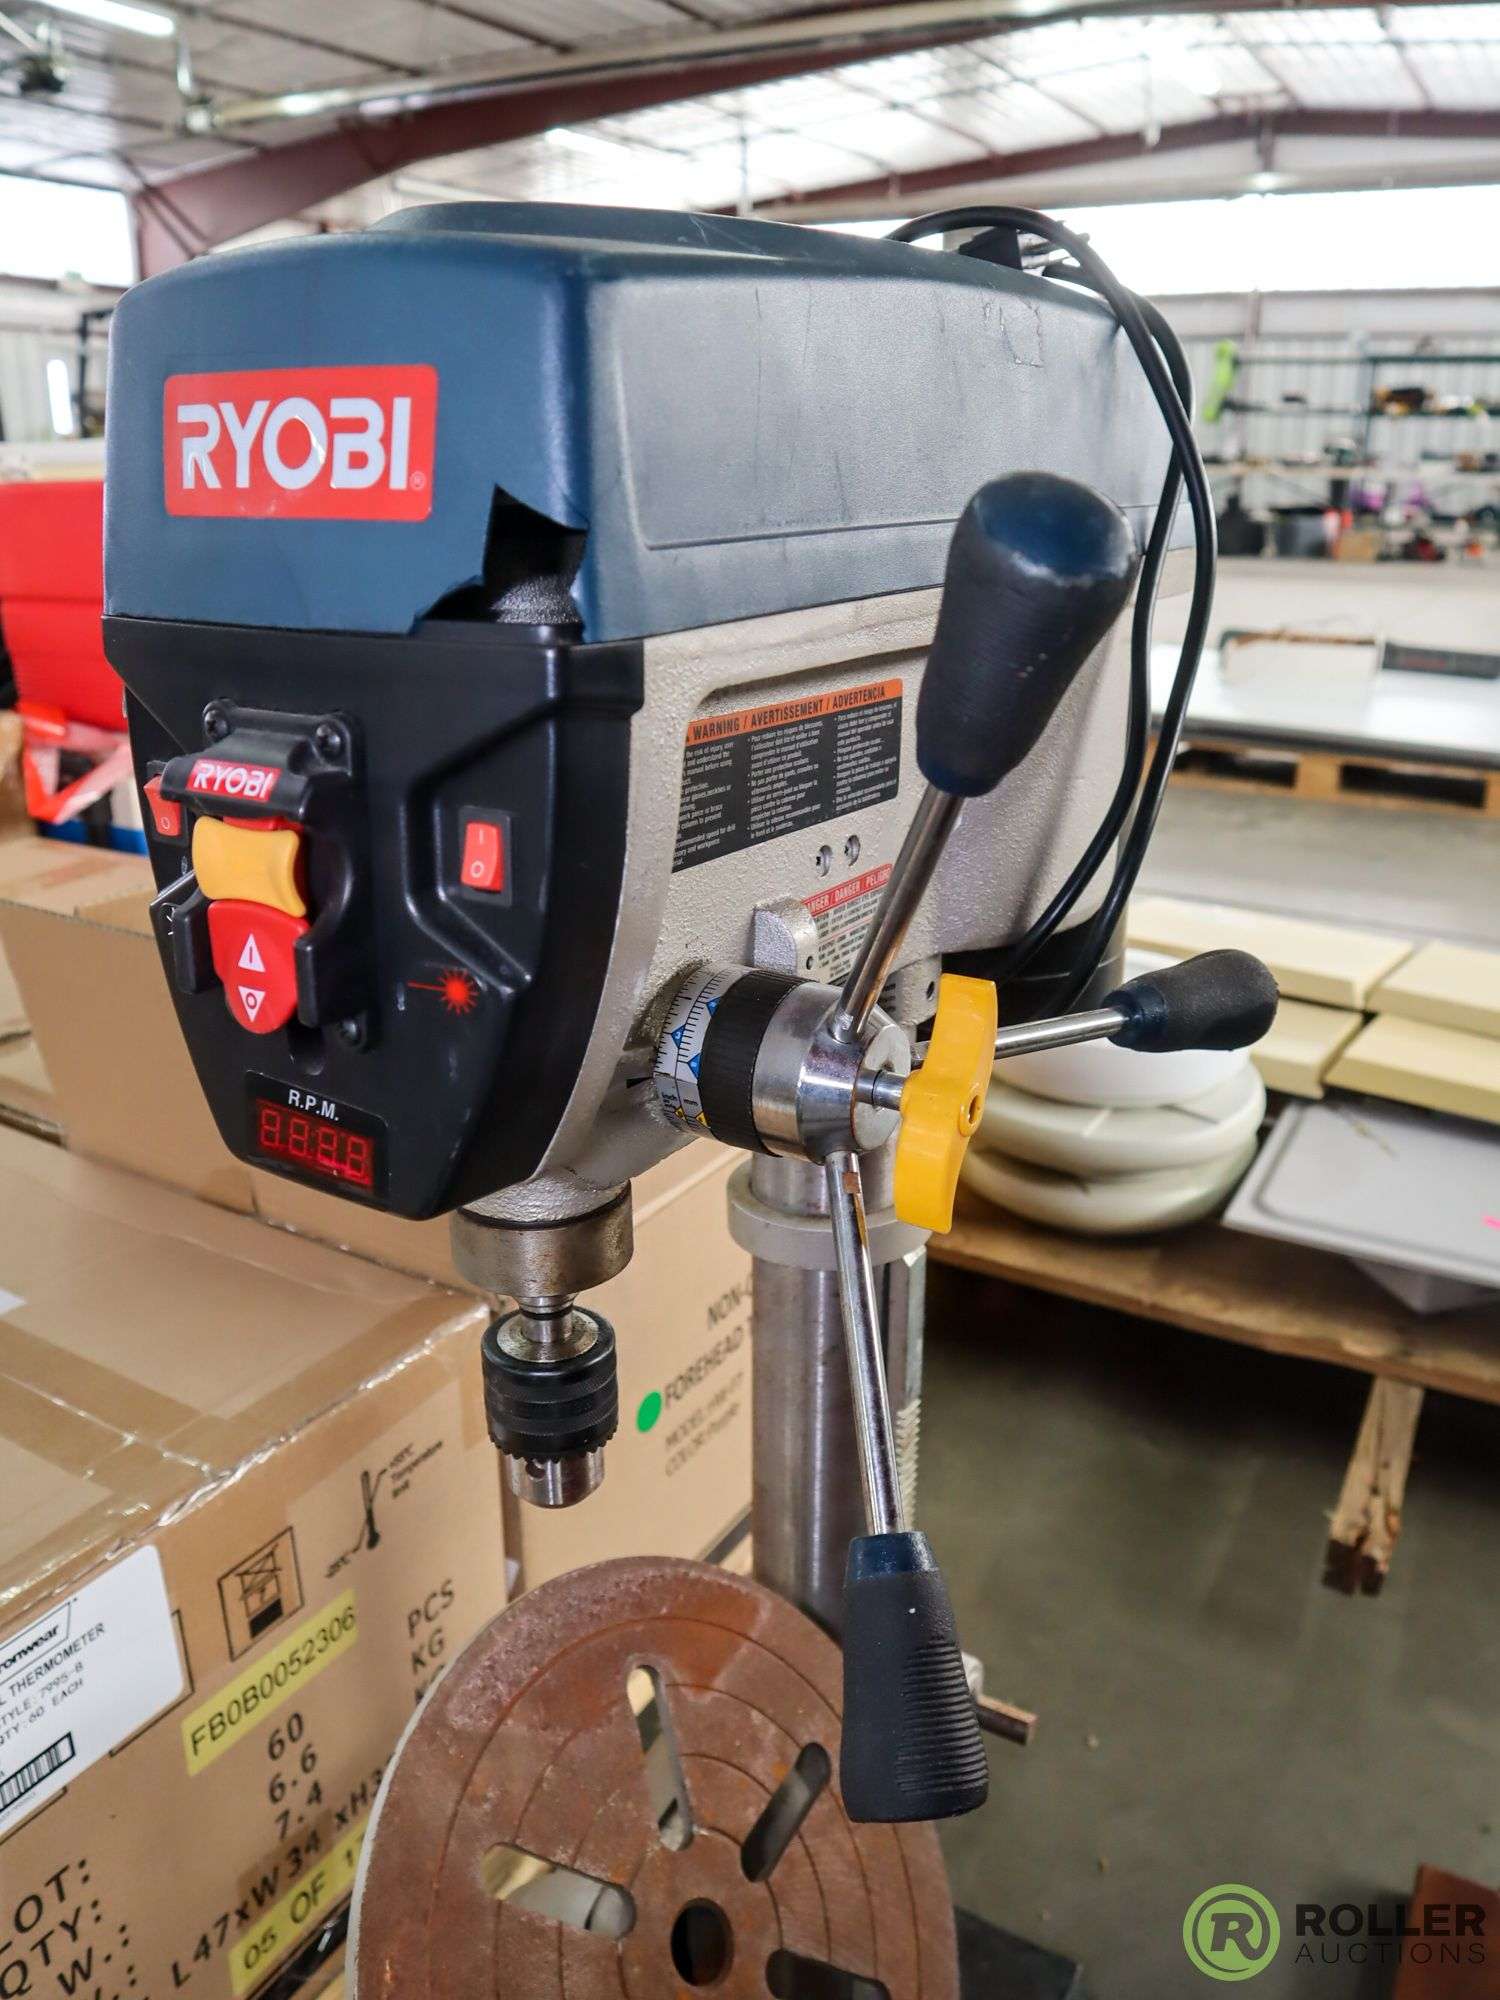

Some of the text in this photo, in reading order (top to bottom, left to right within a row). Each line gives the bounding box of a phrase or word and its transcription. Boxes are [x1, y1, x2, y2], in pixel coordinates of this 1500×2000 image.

[177, 397, 412, 490] RYOBI
[692, 718, 740, 741] WARNING
[751, 699, 823, 728] AVERTISSEMENT
[832, 686, 886, 710] ADVERTENCIA
[193, 763, 274, 799] RYOBI
[288, 1089, 339, 1121] R.P.M.
[407, 1579, 455, 1638] PCS
[9, 1622, 105, 1697] THERMOMETER
[411, 1628, 444, 1674] KG
[267, 1713, 304, 1761] 60
[268, 1743, 317, 1804] 6.6
[243, 1926, 277, 1970] 05
[290, 1871, 326, 1924] OF
